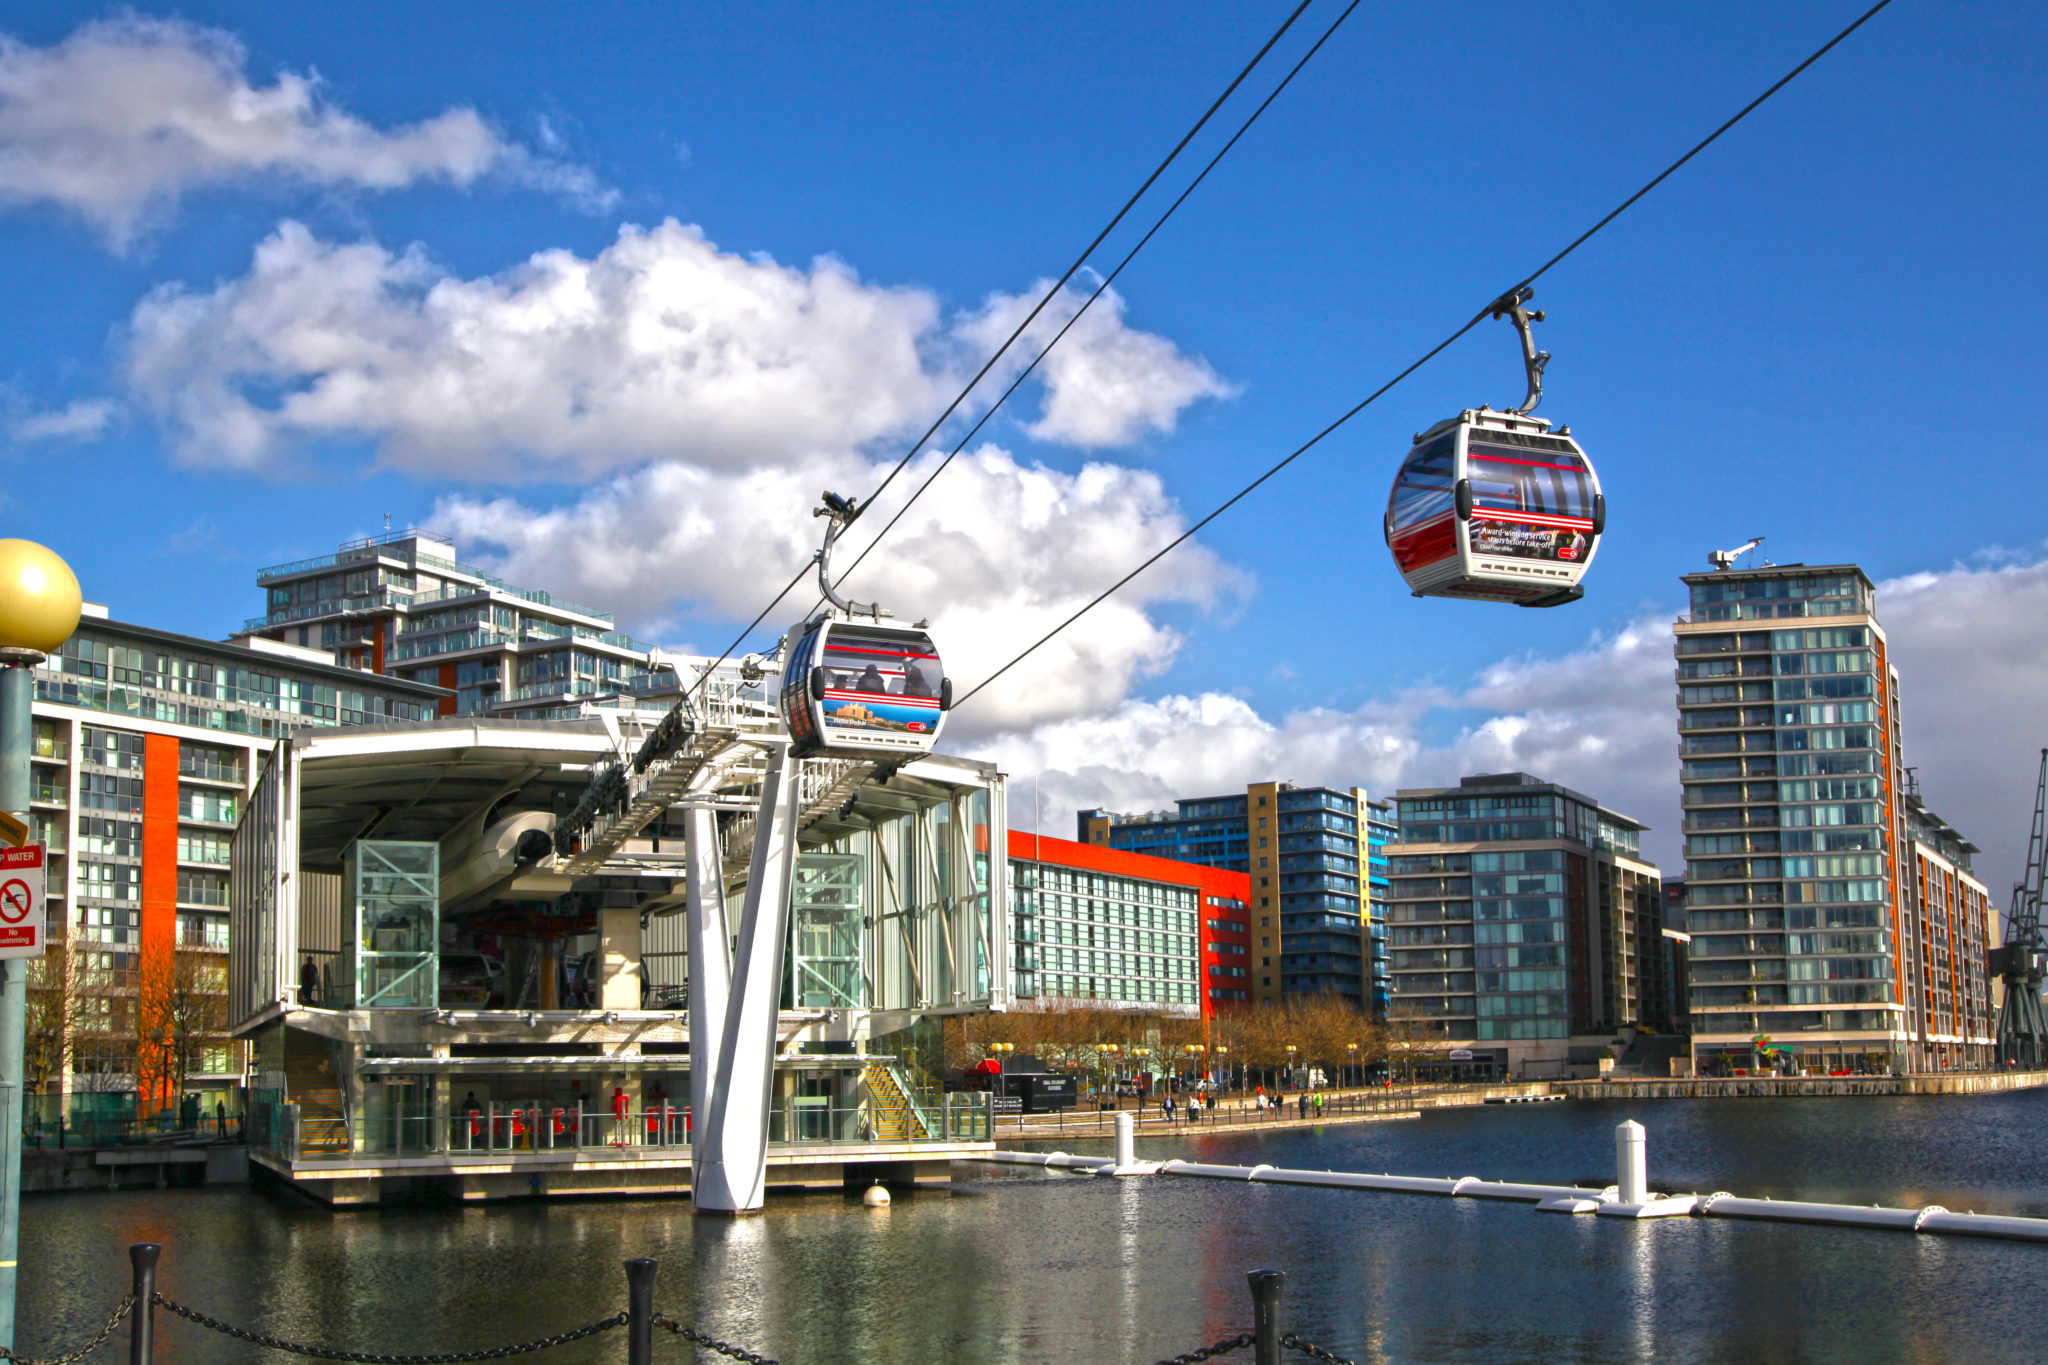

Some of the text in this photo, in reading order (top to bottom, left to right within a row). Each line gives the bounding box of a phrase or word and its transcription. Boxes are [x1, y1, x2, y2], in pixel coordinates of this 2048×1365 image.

[1481, 527, 1551, 541] Award-winning service
[1506, 538, 1526, 546] before
[1526, 540, 1552, 549] take-off
[7, 851, 35, 862] WATER
